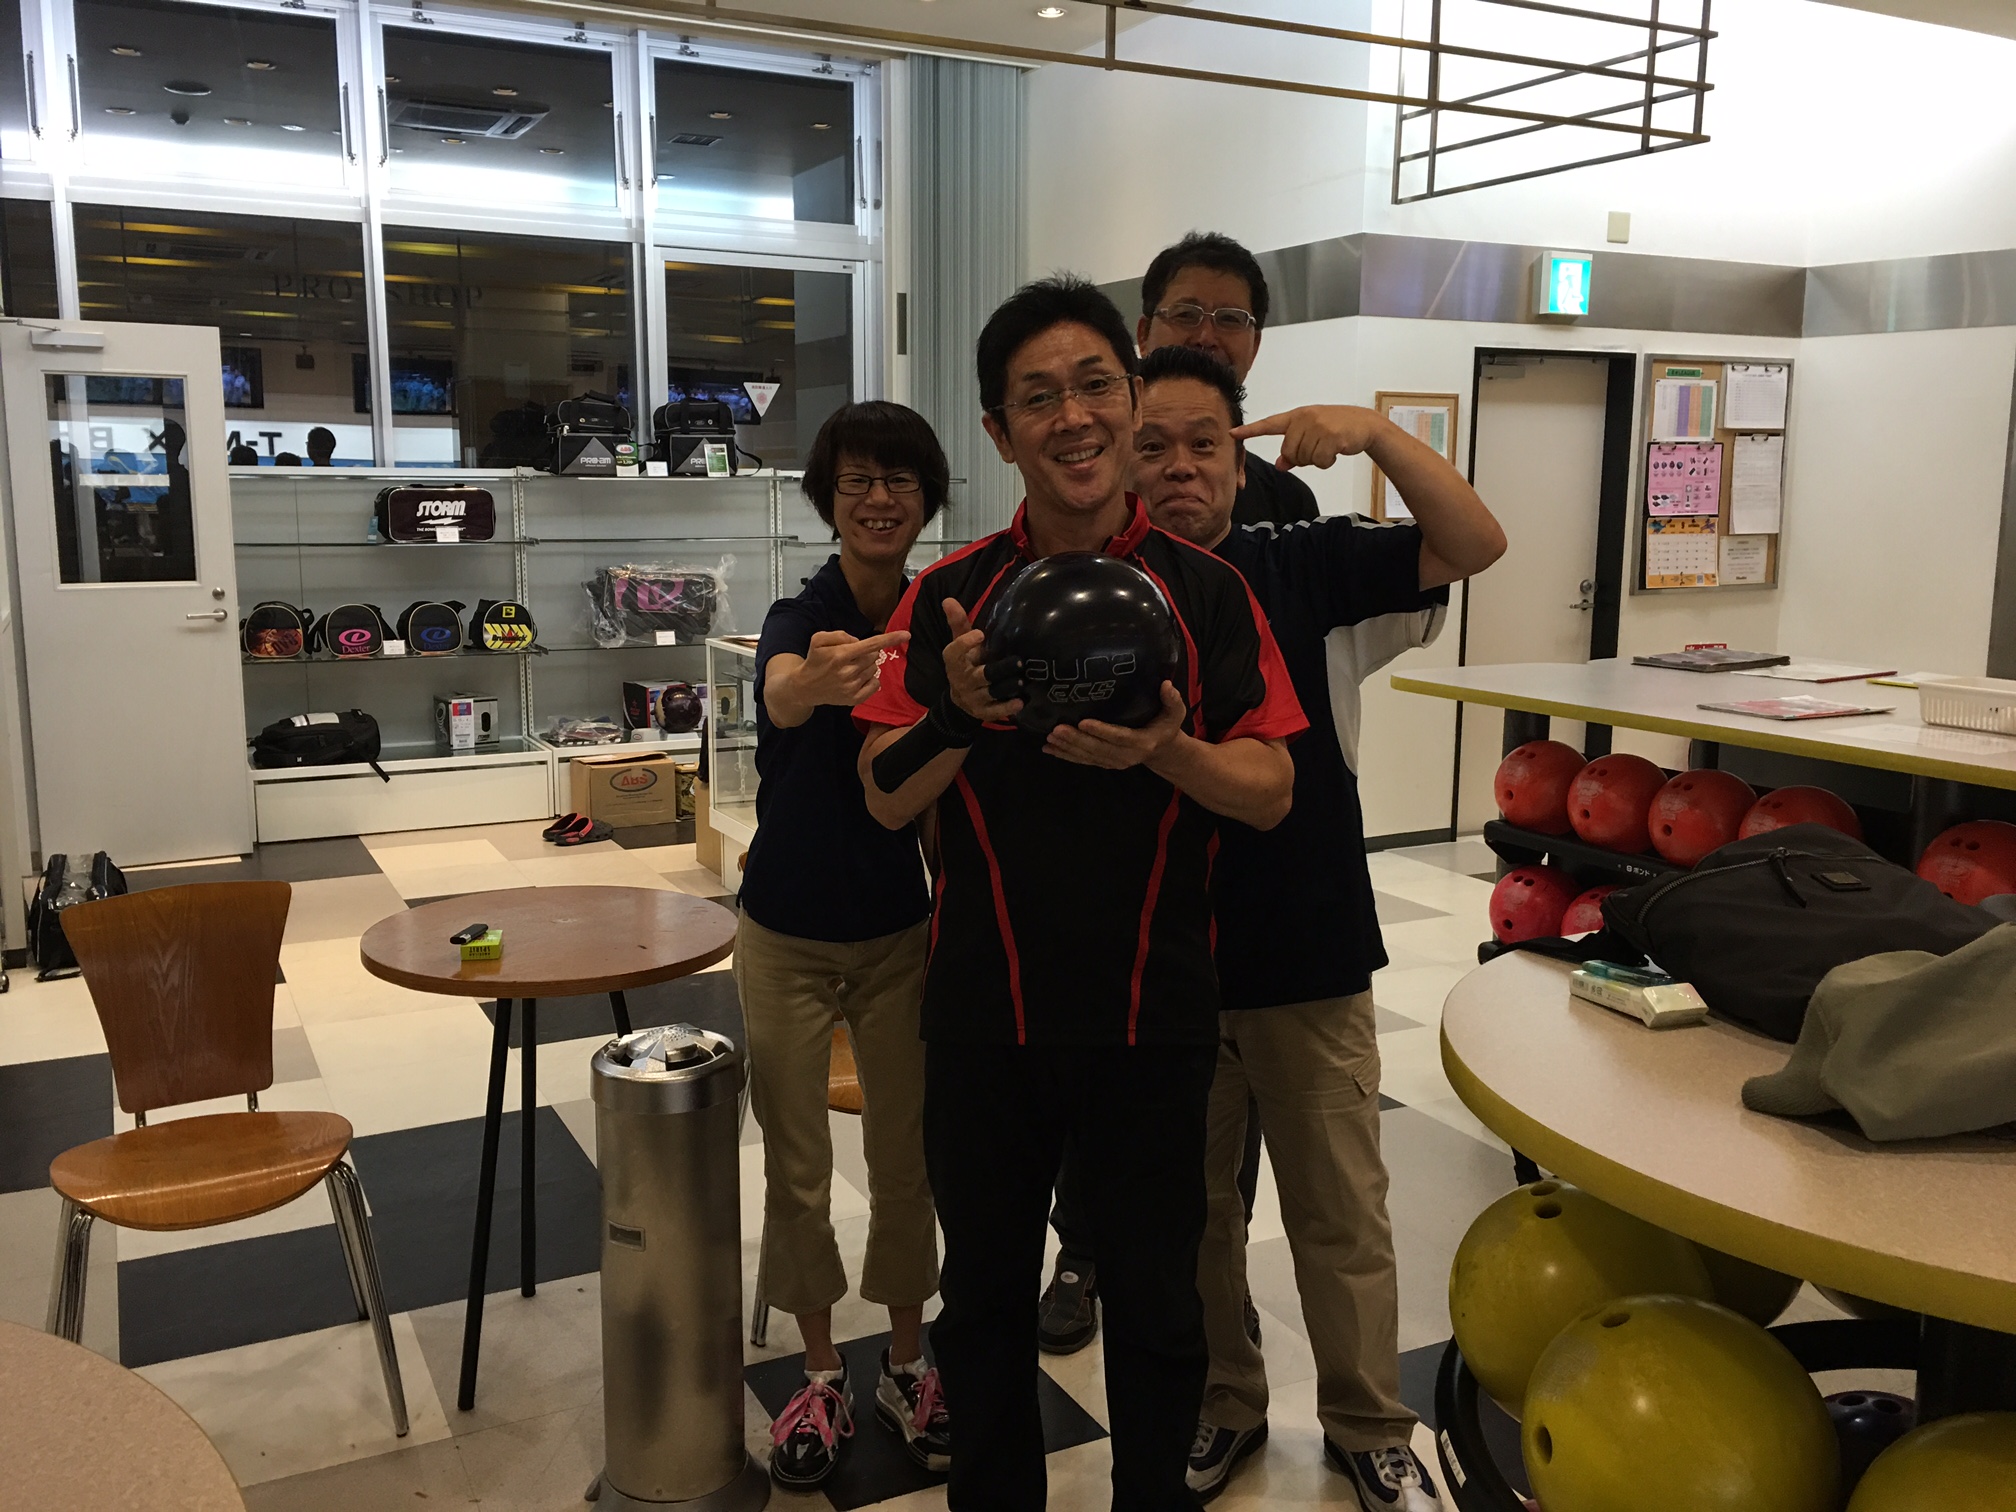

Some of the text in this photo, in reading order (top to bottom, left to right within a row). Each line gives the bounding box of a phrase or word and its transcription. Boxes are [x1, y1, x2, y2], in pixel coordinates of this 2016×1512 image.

[416, 500, 467, 517] STORM
[341, 644, 371, 654] Dexter
[423, 641, 451, 651] Dexter
[1025, 652, 1136, 681] aura
